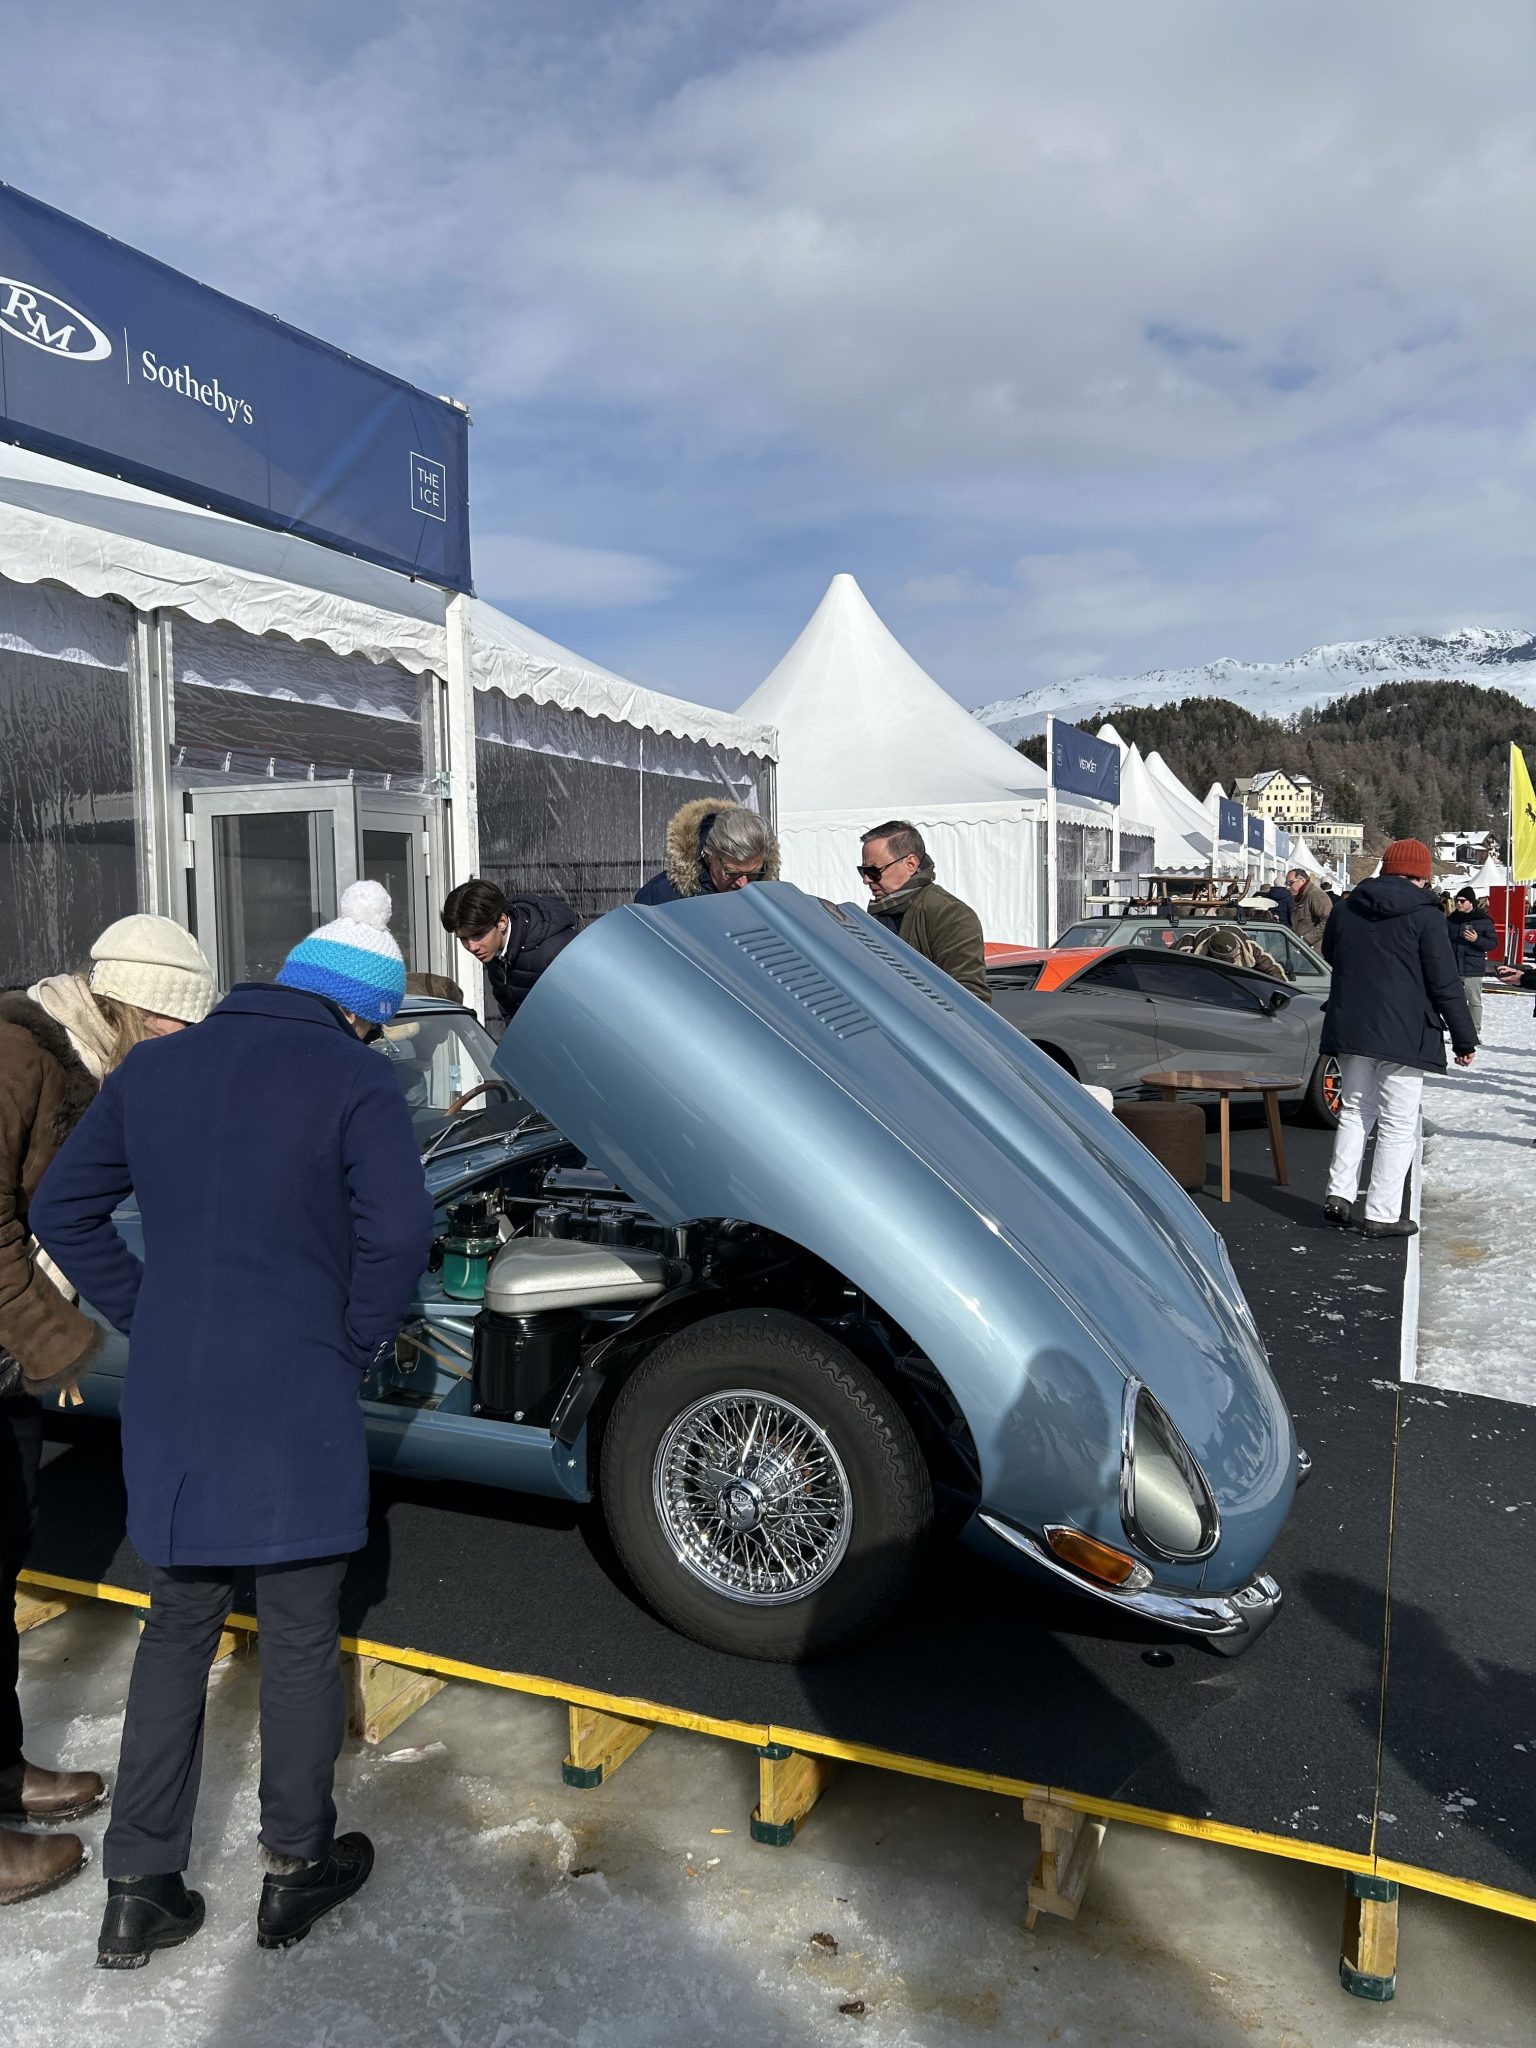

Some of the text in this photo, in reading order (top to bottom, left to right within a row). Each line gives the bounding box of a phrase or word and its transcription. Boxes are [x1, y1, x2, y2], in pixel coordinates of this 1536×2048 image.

[1, 285, 254, 425] RM Sotheby's
[417, 467, 439, 489] THE
[420, 486, 440, 507] ICE
